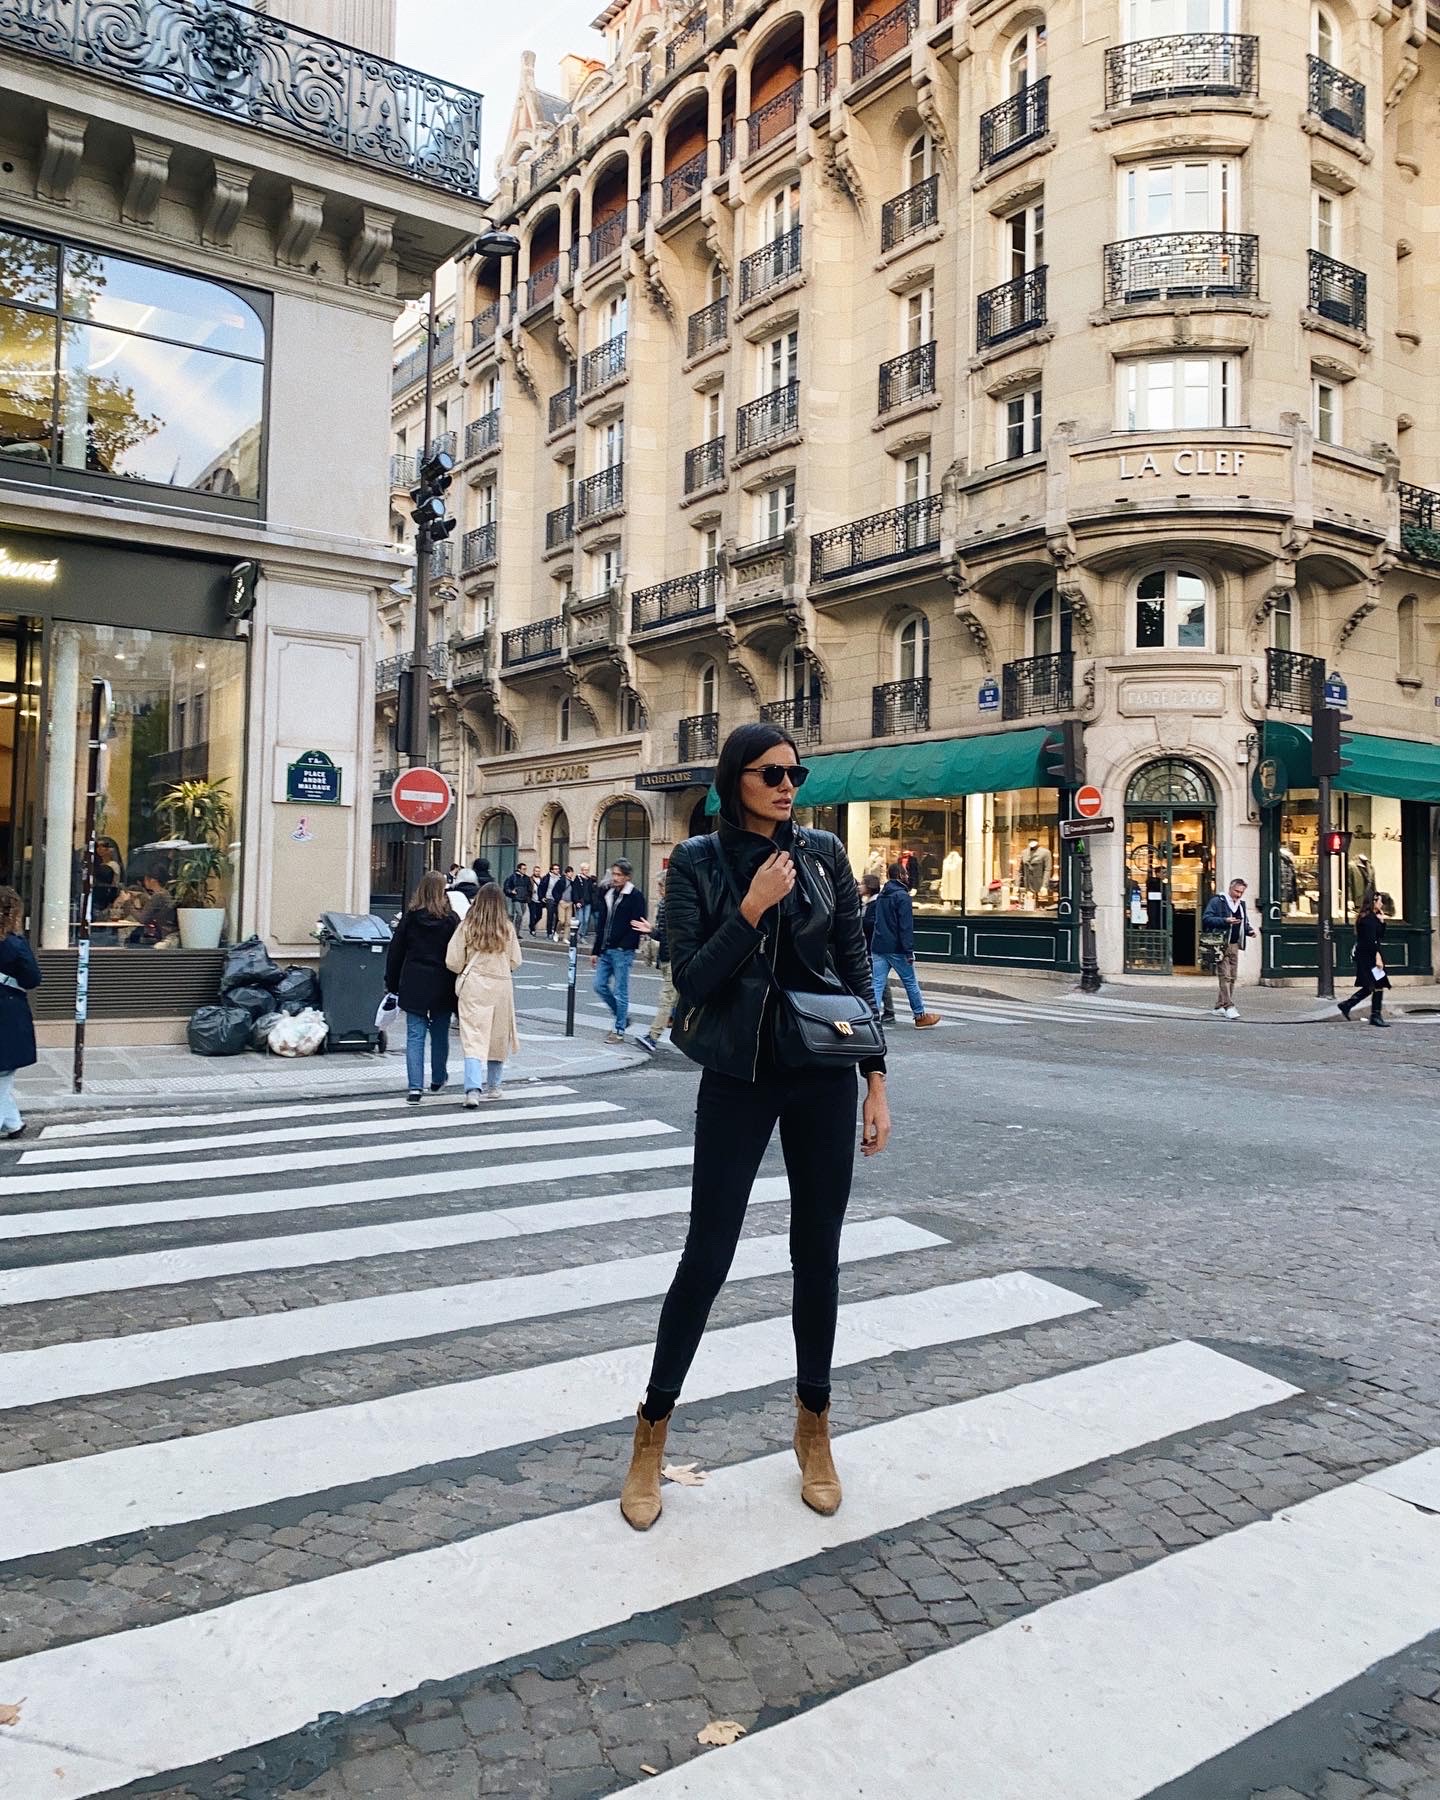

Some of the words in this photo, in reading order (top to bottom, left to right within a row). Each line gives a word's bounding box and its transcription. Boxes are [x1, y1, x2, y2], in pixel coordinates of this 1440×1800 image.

[1119, 453, 1161, 480] LA
[1174, 450, 1247, 476] CLEF
[303, 776, 327, 784] ANDRÉ
[524, 770, 535, 786] LA
[536, 766, 554, 784] CLEF
[556, 763, 590, 782] LOUVRE
[641, 775, 651, 786] LA
[651, 774, 666, 785] CLEF
[666, 771, 692, 783] LOUVRE
[297, 783, 332, 791] MALRAUX
